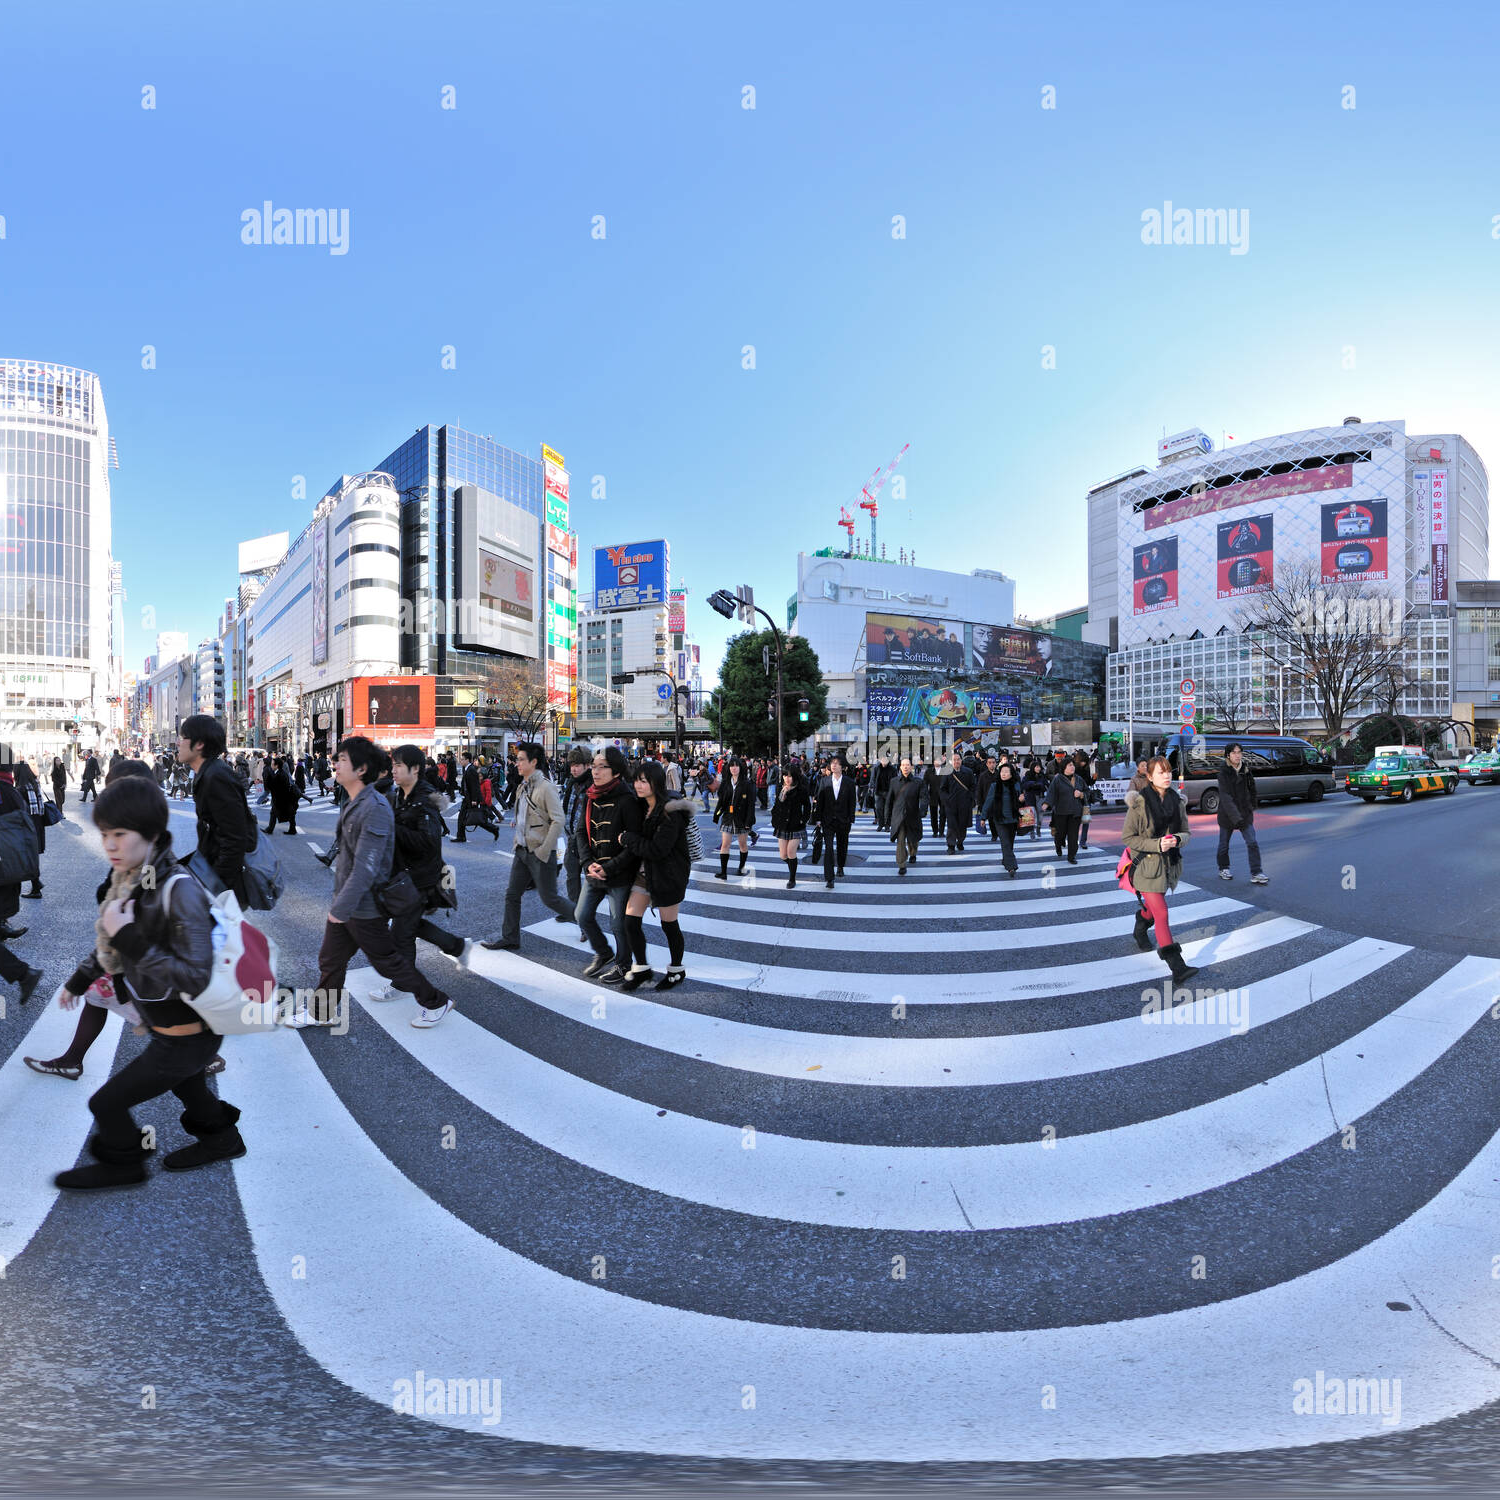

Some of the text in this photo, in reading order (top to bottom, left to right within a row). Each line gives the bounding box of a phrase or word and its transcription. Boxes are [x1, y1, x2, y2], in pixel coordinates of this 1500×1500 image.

[1174, 497, 1213, 519] 2010
[1433, 481, 1443, 532] 男の総決算
[1323, 570, 1386, 583] The SMARTPHONE
[597, 584, 661, 608] 武富士
[840, 586, 949, 608] TOKYU
[1218, 590, 1229, 599] The
[1144, 599, 1177, 613] SMARTPHONE
[904, 651, 942, 663] SoftBank
[870, 672, 887, 683] JR
